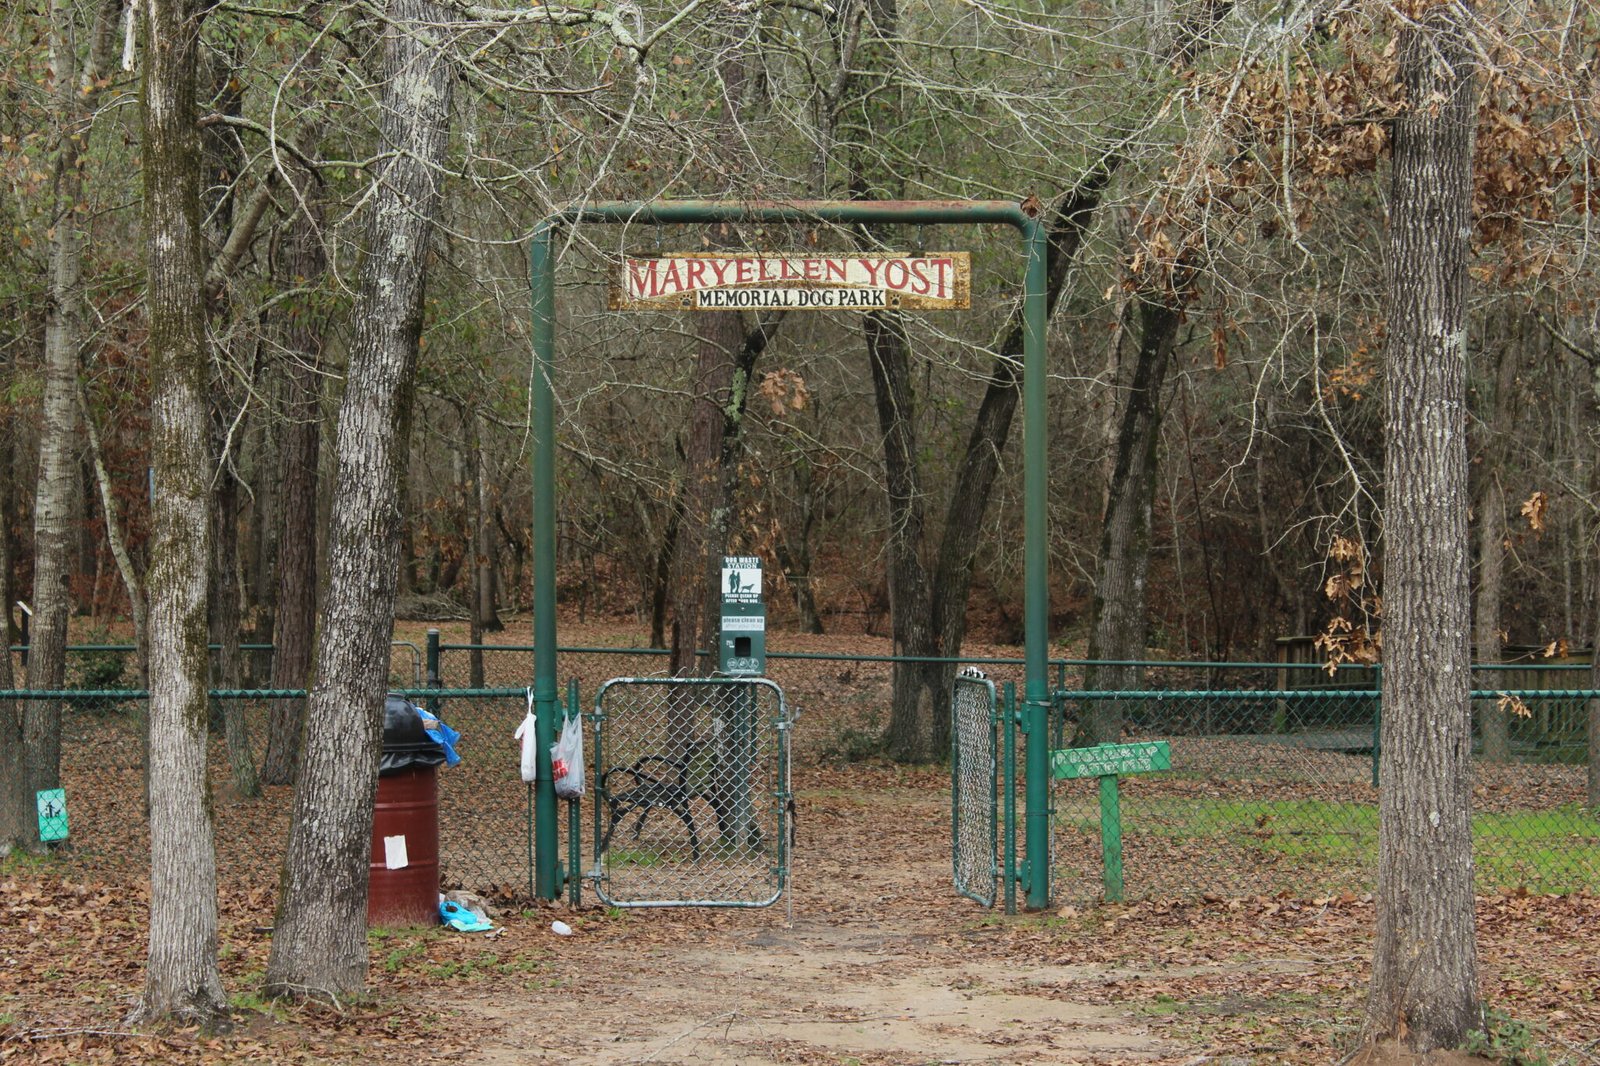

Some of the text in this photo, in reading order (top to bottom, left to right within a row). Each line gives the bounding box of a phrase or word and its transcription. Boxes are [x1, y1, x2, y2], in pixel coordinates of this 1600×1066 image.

[627, 257, 953, 301] MARYELLEN YOST
[699, 289, 885, 308] MEMORIAL DOG PARK
